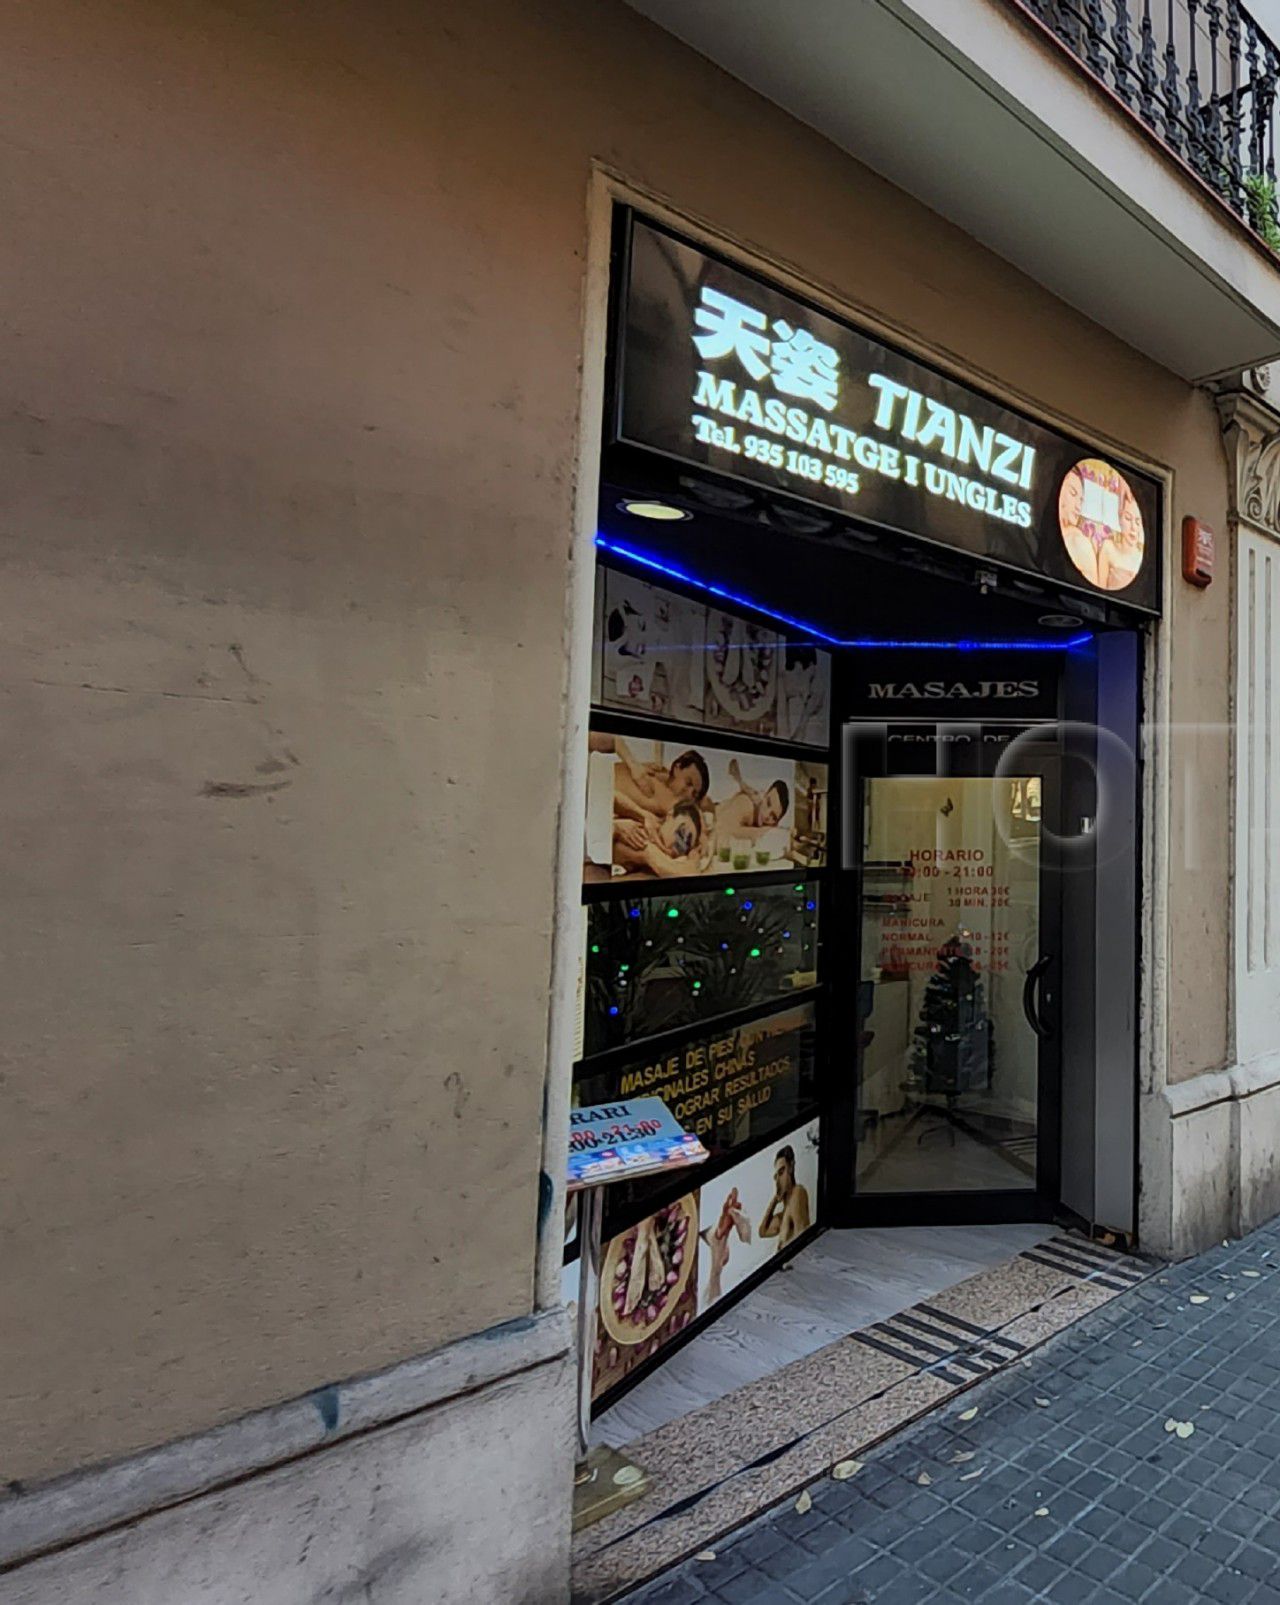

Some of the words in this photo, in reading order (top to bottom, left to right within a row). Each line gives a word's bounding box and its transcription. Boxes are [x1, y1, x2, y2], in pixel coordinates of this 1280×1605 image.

[692, 286, 840, 411] 天姿
[691, 415, 740, 453] Tel.
[744, 435, 783, 469] 935
[786, 451, 822, 484] 103
[824, 466, 860, 495] 595
[692, 371, 901, 479] MASSATGE
[903, 453, 919, 485] I
[924, 468, 1032, 528] UNGLES
[868, 373, 1035, 490] TIANZI
[867, 680, 1041, 699] MASAJES
[900, 865, 940, 878] 0:00
[953, 865, 993, 877] 21:00
[909, 849, 984, 861] HORARIO
[881, 917, 945, 928] MANICURA
[620, 1056, 680, 1095] MASAJE
[685, 1048, 705, 1070] DE
[674, 1087, 720, 1120] OGRAR
[724, 1055, 792, 1098] RESULTADOS
[714, 1050, 756, 1081] CHINAS
[570, 1105, 633, 1126] RARI
[696, 1115, 713, 1135] EN
[717, 1103, 733, 1125] SU
[737, 1085, 772, 1116] SALUD
